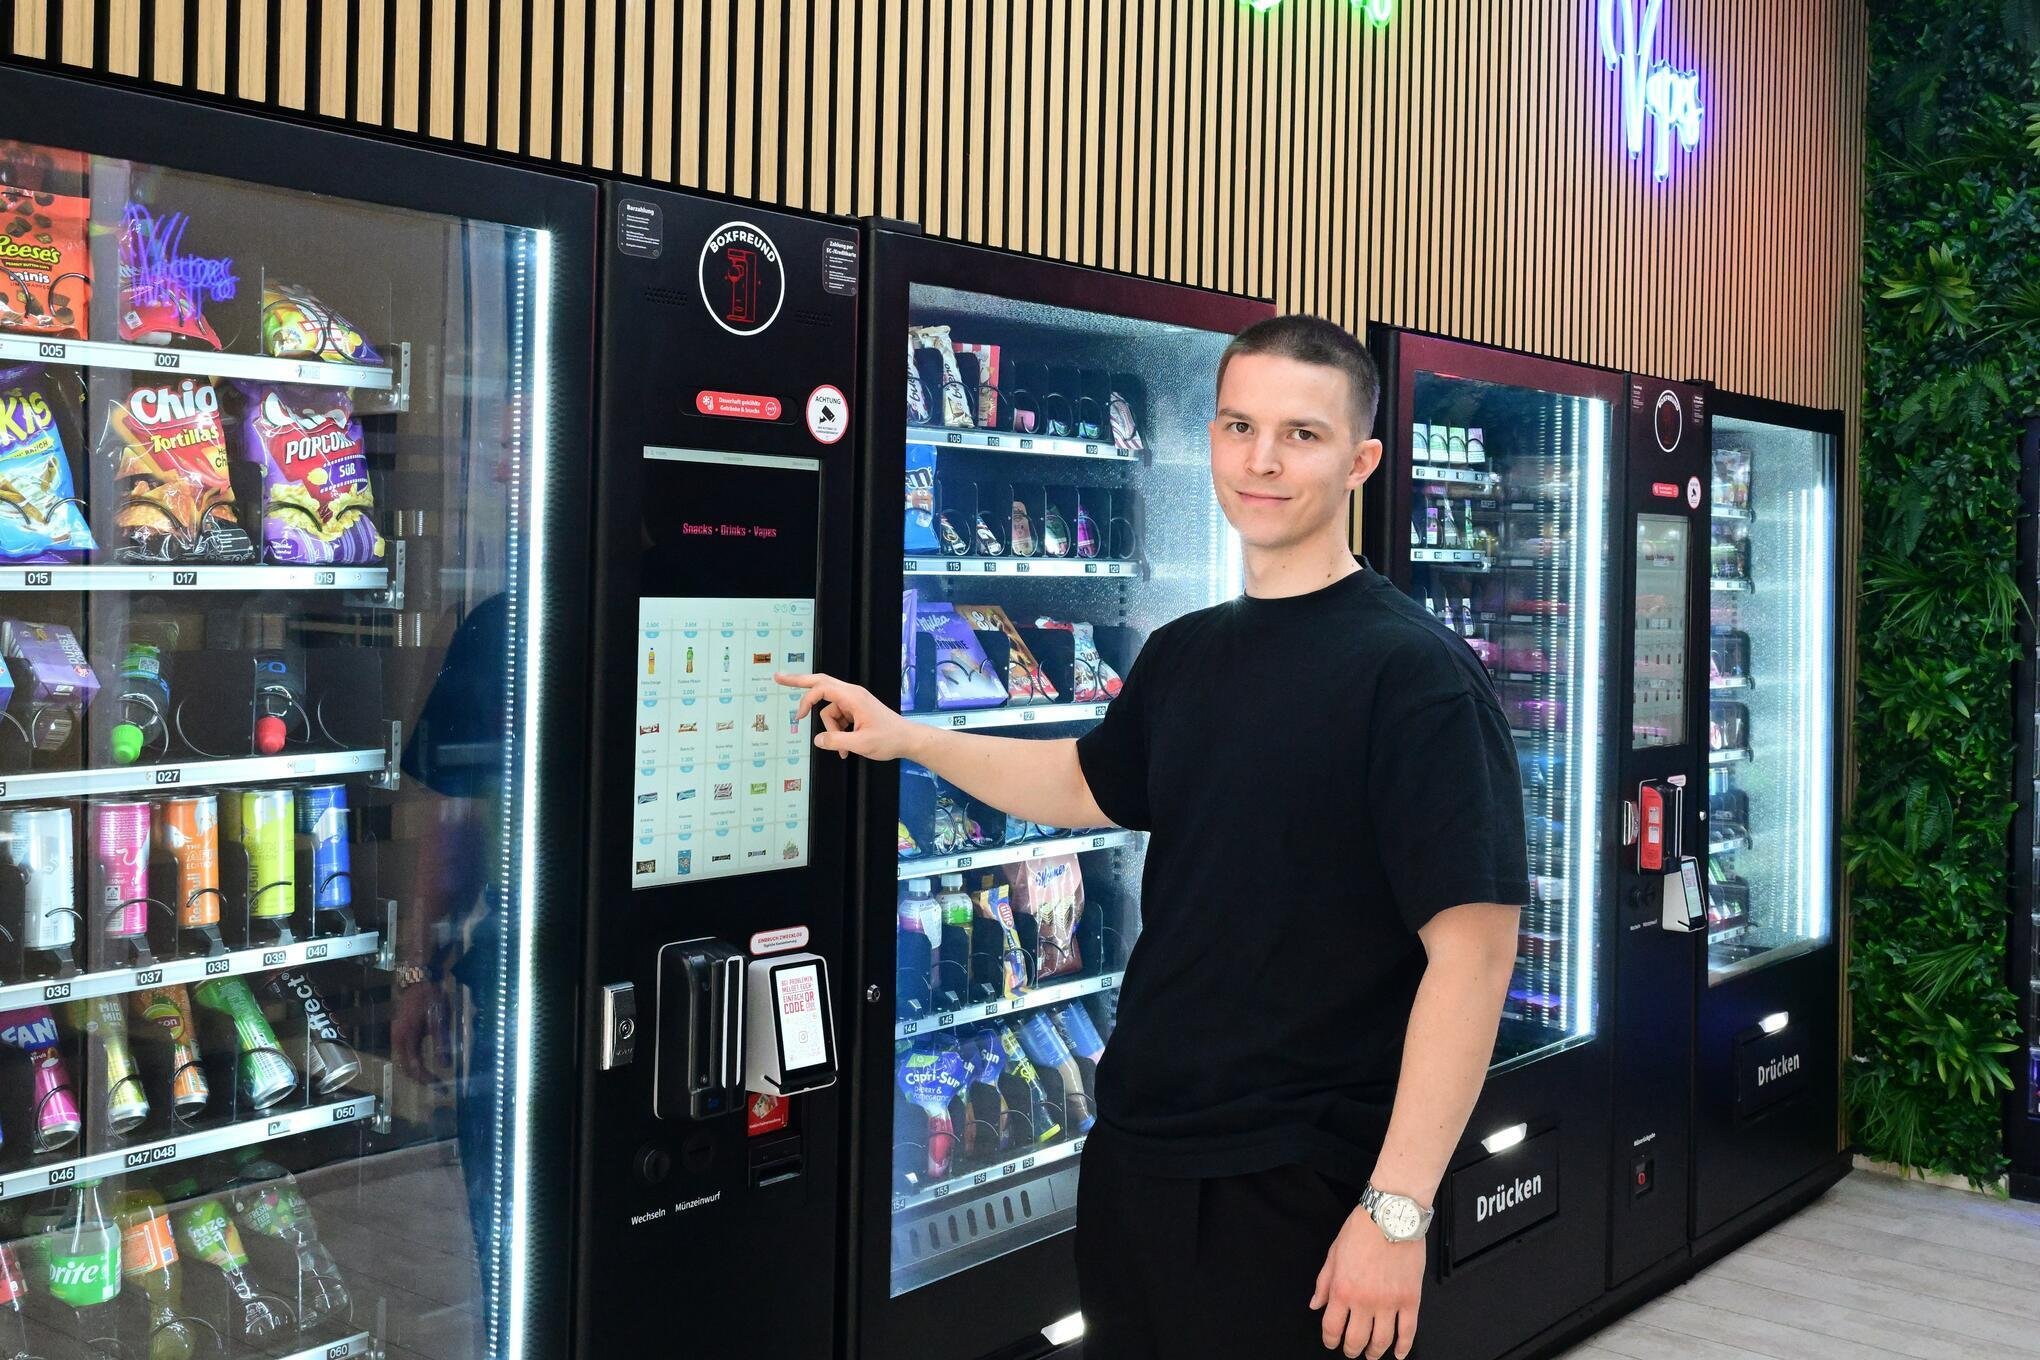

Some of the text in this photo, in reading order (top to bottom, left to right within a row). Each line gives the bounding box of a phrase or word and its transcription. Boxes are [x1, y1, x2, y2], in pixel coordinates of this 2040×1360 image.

[626, 204, 655, 216] Barzahlung
[709, 230, 776, 264] BOXFREUND
[41, 345, 64, 357] 005
[157, 355, 179, 367] 007
[130, 380, 219, 425] Chio
[815, 395, 842, 405] ACHTUNG
[0, 391, 52, 446] KIS
[151, 424, 220, 453] Tortillas
[339, 463, 356, 478] Süß
[682, 522, 777, 538] Snacks Drinks Vapes
[949, 562, 961, 571] 115
[28, 571, 50, 584] 015
[175, 572, 197, 584] 017
[316, 571, 334, 584] 019
[916, 614, 950, 632] Milka
[157, 770, 180, 782] 027
[758, 936, 779, 944] EINBRUCH
[306, 945, 327, 957] 040
[265, 952, 286, 964] 039
[207, 961, 229, 973] 038
[140, 971, 162, 983] 037
[46, 985, 69, 998] 036
[783, 993, 804, 1003] EINFACH
[99, 1002, 120, 1012] MIO
[784, 1001, 805, 1015] CODE
[904, 1024, 917, 1034] 144
[1758, 1052, 1800, 1087] Drücken
[905, 1072, 961, 1088] Capri-Sun
[337, 1107, 355, 1119] 050
[154, 1146, 175, 1158] 048
[128, 1152, 150, 1165] 047
[51, 1168, 74, 1181] 046
[1004, 1164, 1015, 1174] 157
[936, 1187, 948, 1196] 155
[675, 1191, 721, 1213] Münzeinwurf
[1476, 1174, 1542, 1223] Drücken
[892, 1200, 905, 1210] 154
[631, 1208, 666, 1226] Wechseln
[330, 1346, 348, 1358] 060
